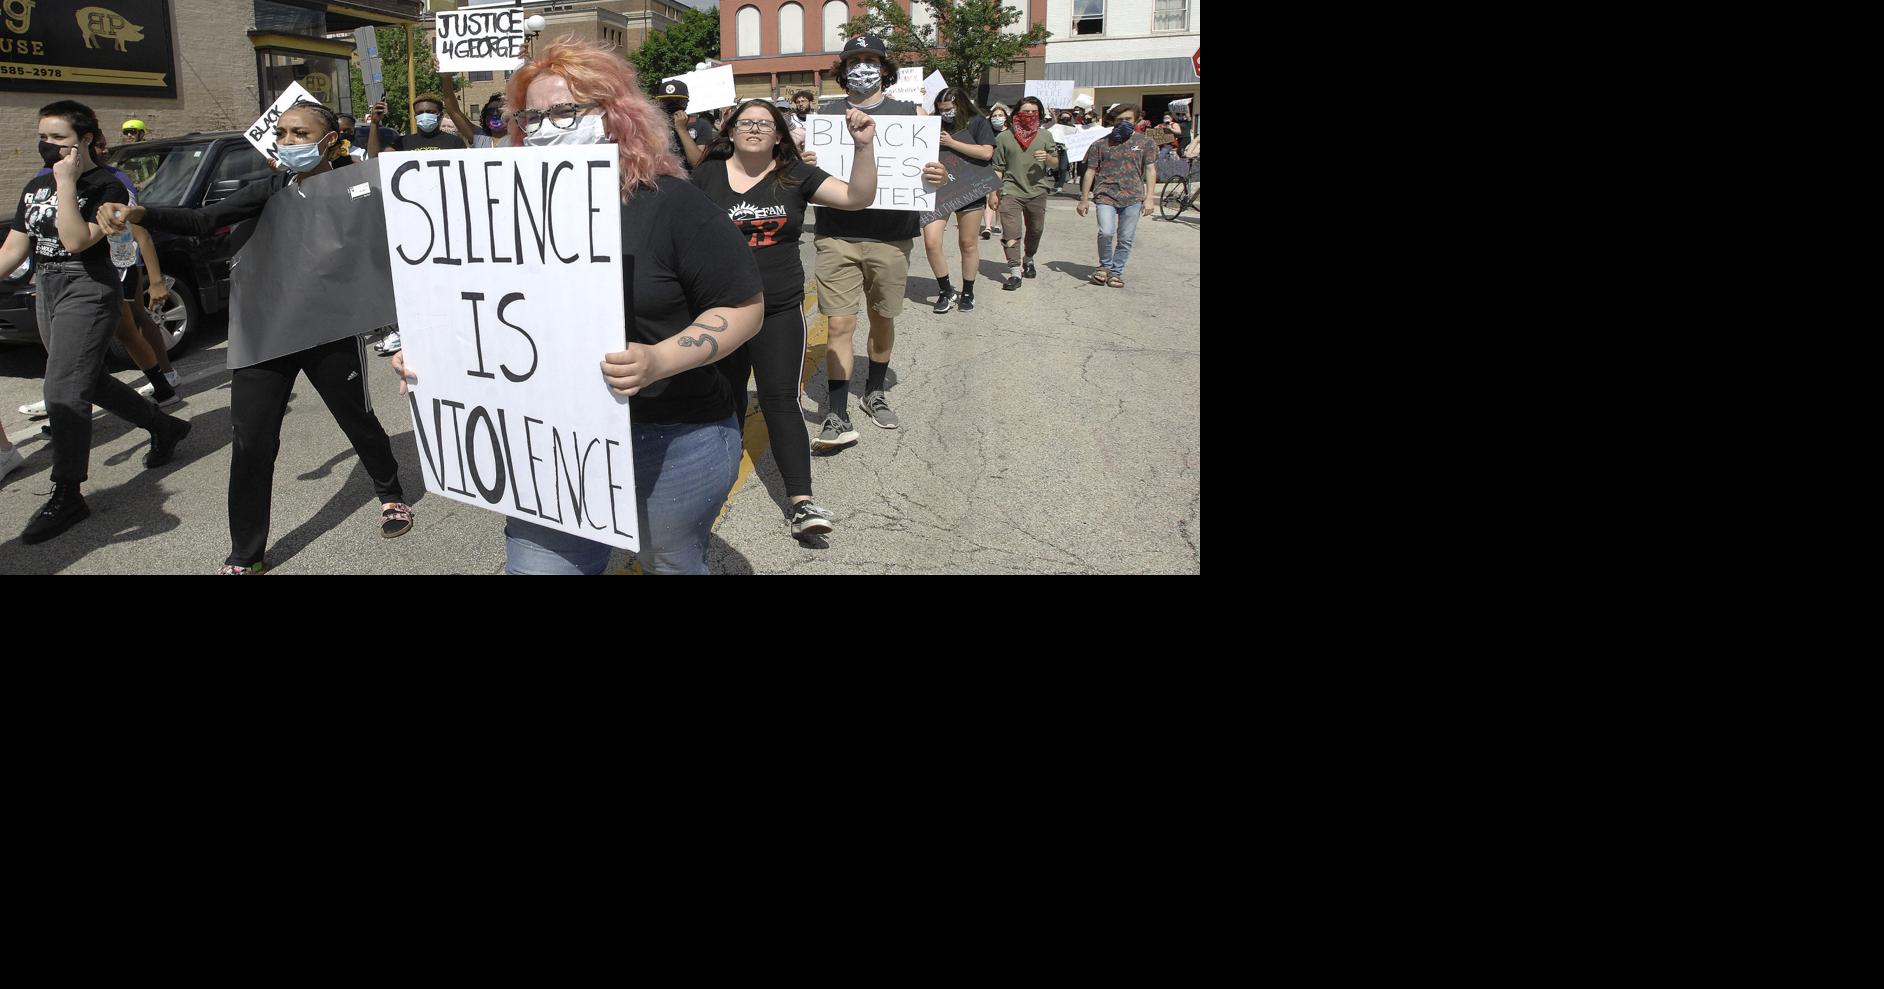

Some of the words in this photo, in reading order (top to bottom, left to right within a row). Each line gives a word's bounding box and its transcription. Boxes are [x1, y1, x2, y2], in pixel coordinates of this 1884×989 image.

[438, 9, 523, 38] JUSTICE
[249, 104, 283, 142] BLACK
[391, 160, 610, 265] SILENCE
[763, 205, 787, 217] FAM
[461, 292, 538, 382] IS
[408, 391, 634, 539] VIOLENCE
